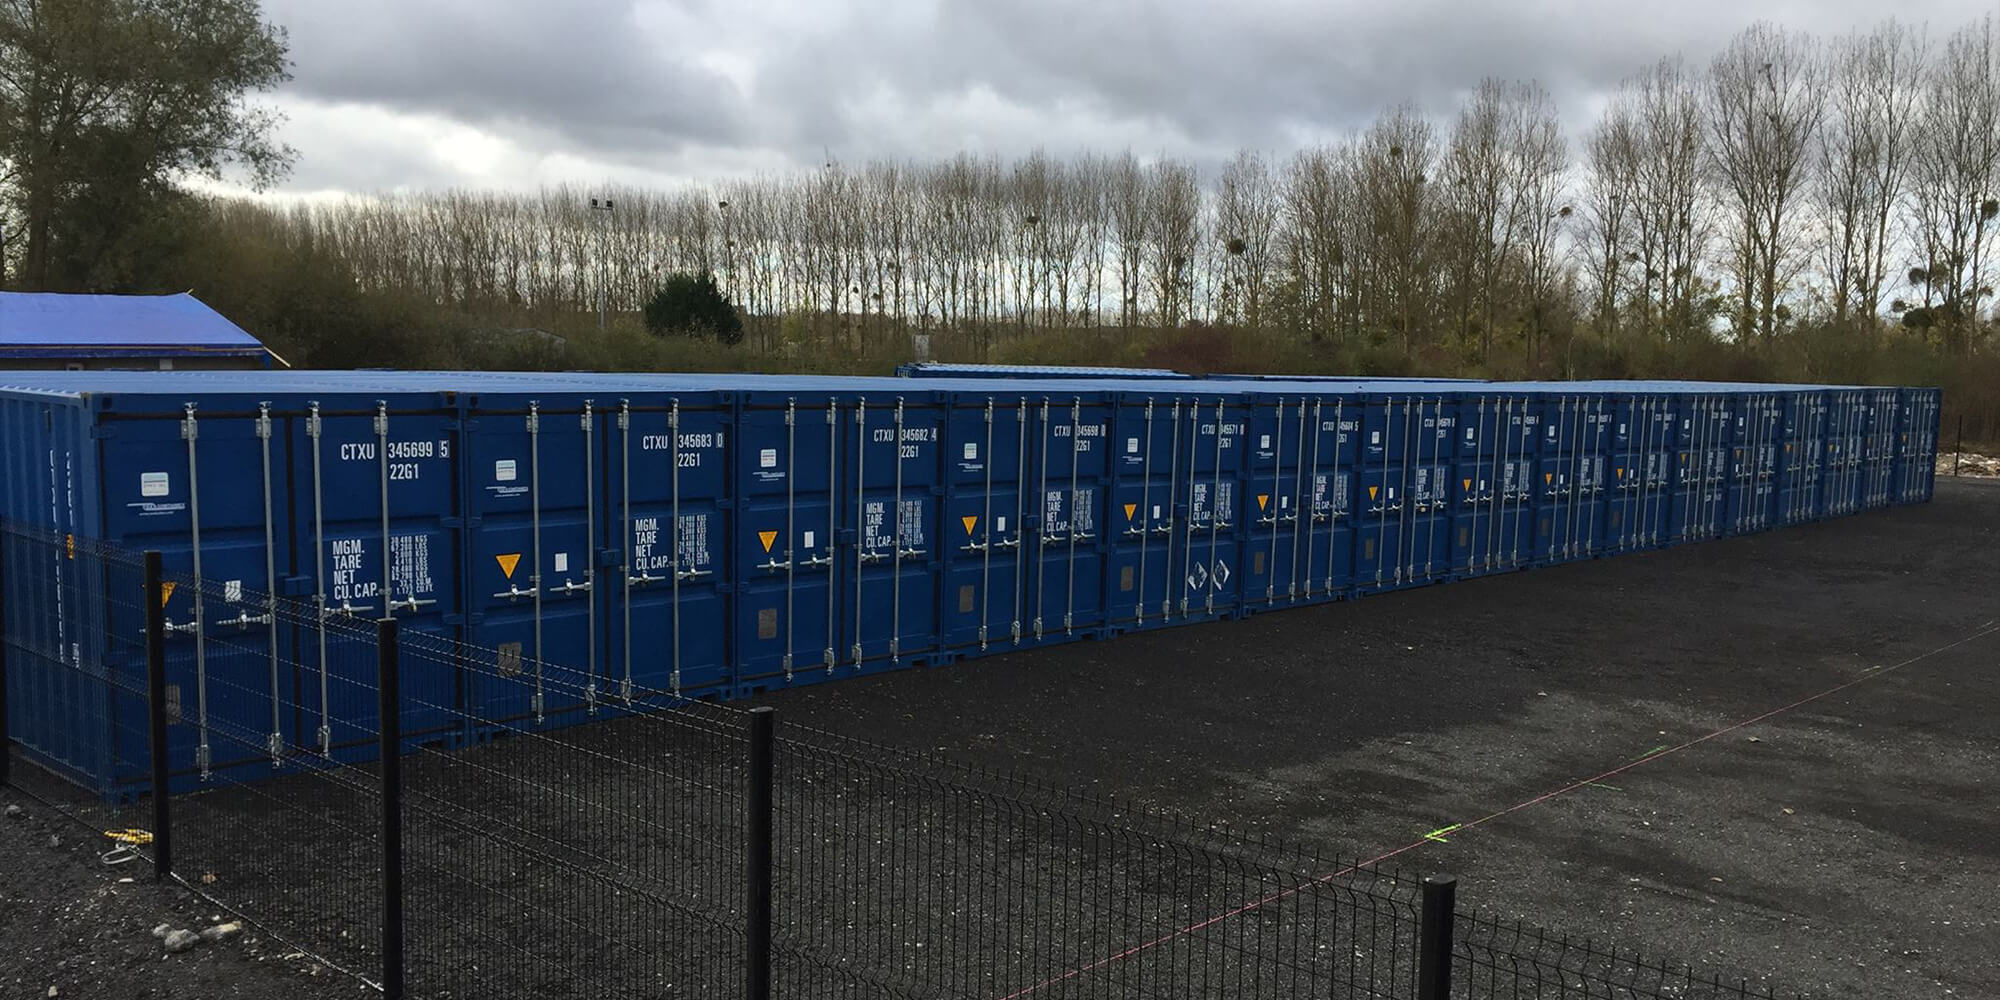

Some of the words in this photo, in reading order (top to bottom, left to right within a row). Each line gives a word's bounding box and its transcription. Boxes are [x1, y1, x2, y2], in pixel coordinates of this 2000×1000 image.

[873, 429, 895, 442] CTXU
[901, 428, 929, 441] 345682
[1054, 425, 1071, 437] CTXU
[643, 435, 668, 450] CTXU
[678, 433, 712, 448] 345683
[341, 443, 375, 460] CTXU
[387, 441, 433, 458] 345699
[440, 440, 449, 458] 5
[901, 445, 919, 458] 22G1
[678, 452, 701, 467] 22G1
[390, 463, 419, 480] 22G1
[866, 502, 885, 513] MGM.
[635, 518, 659, 531] MGM.
[866, 513, 883, 525] TARE
[635, 531, 657, 544] TARE
[866, 525, 879, 537] NET
[333, 539, 365, 555] MGM.
[635, 544, 652, 558] NET
[333, 554, 362, 570] TARE
[333, 569, 355, 585] NET
